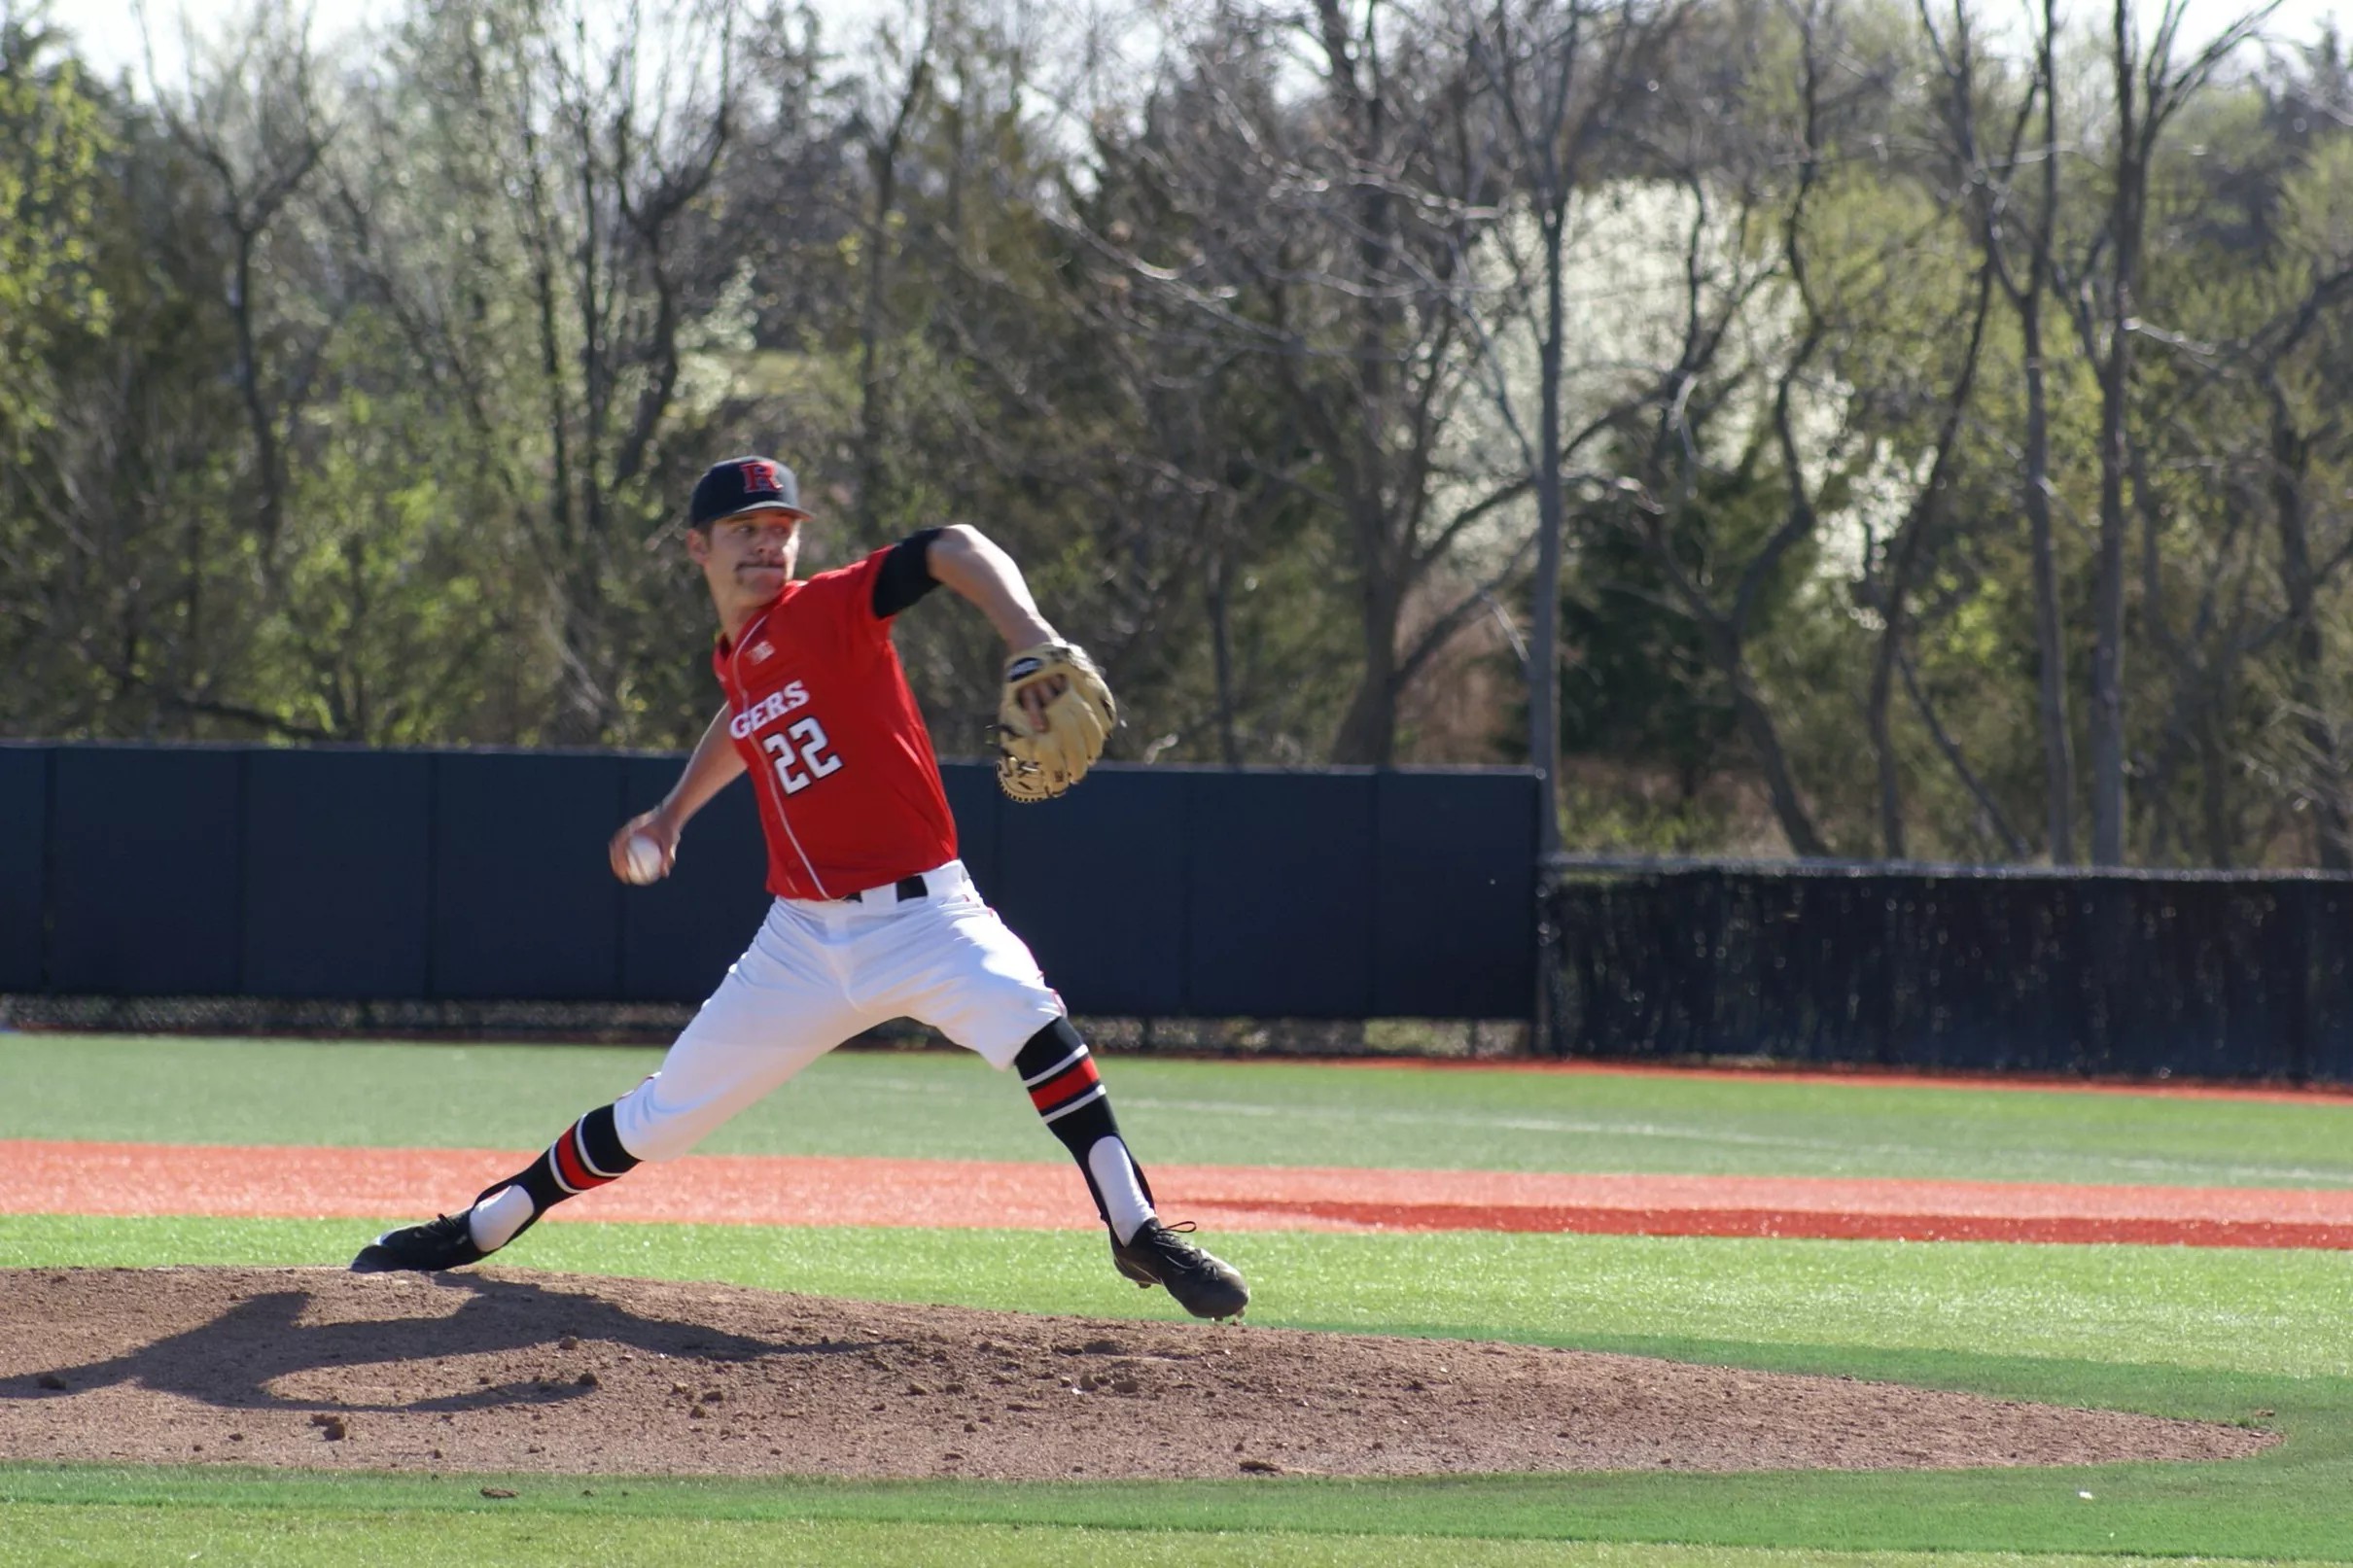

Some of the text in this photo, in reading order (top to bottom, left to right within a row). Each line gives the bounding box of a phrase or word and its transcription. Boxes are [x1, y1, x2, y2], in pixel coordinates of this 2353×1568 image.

[740, 461, 784, 493] R
[729, 679, 810, 739] GERS
[762, 716, 844, 795] 22
